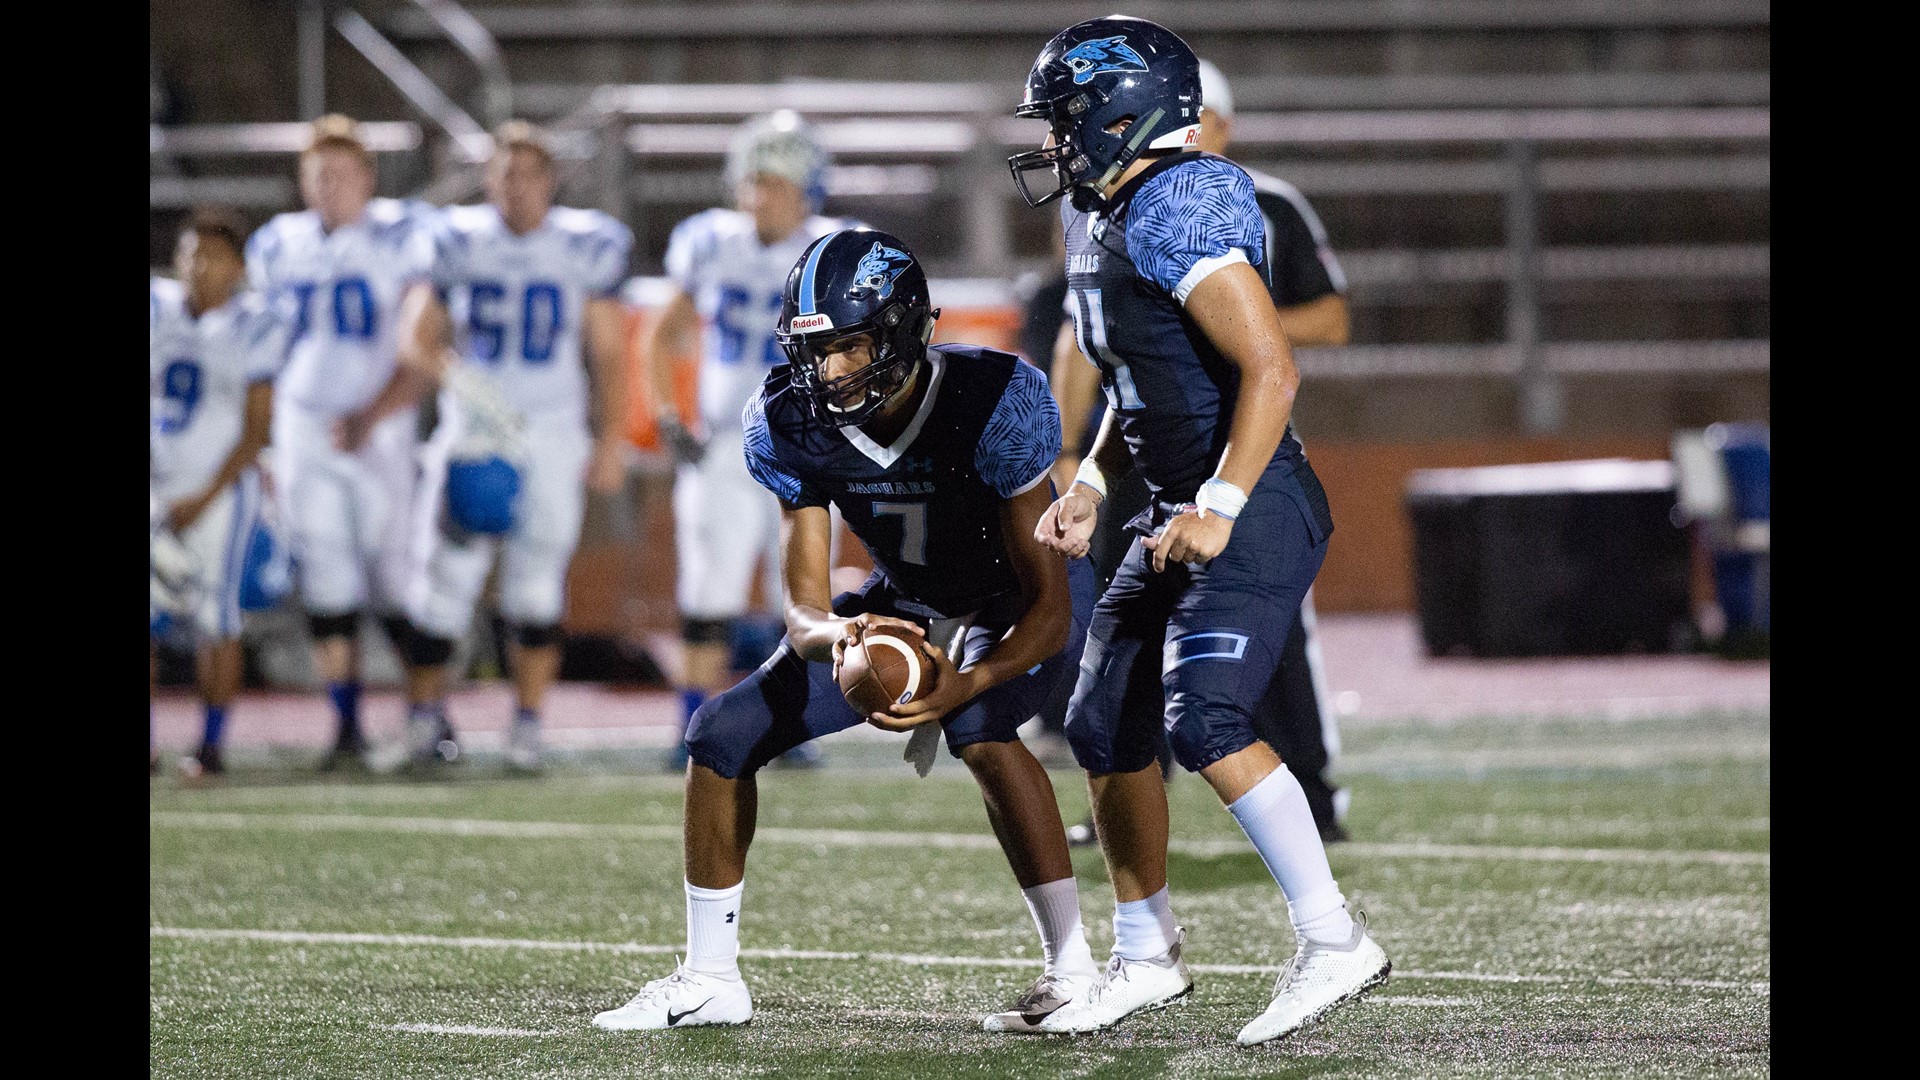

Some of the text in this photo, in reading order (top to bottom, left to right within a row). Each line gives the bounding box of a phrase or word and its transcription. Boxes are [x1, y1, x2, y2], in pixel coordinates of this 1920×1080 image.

[792, 316, 825, 329] Riddell
[158, 358, 204, 434] 9
[846, 481, 936, 495] JAGUARS
[872, 501, 929, 566] 7
